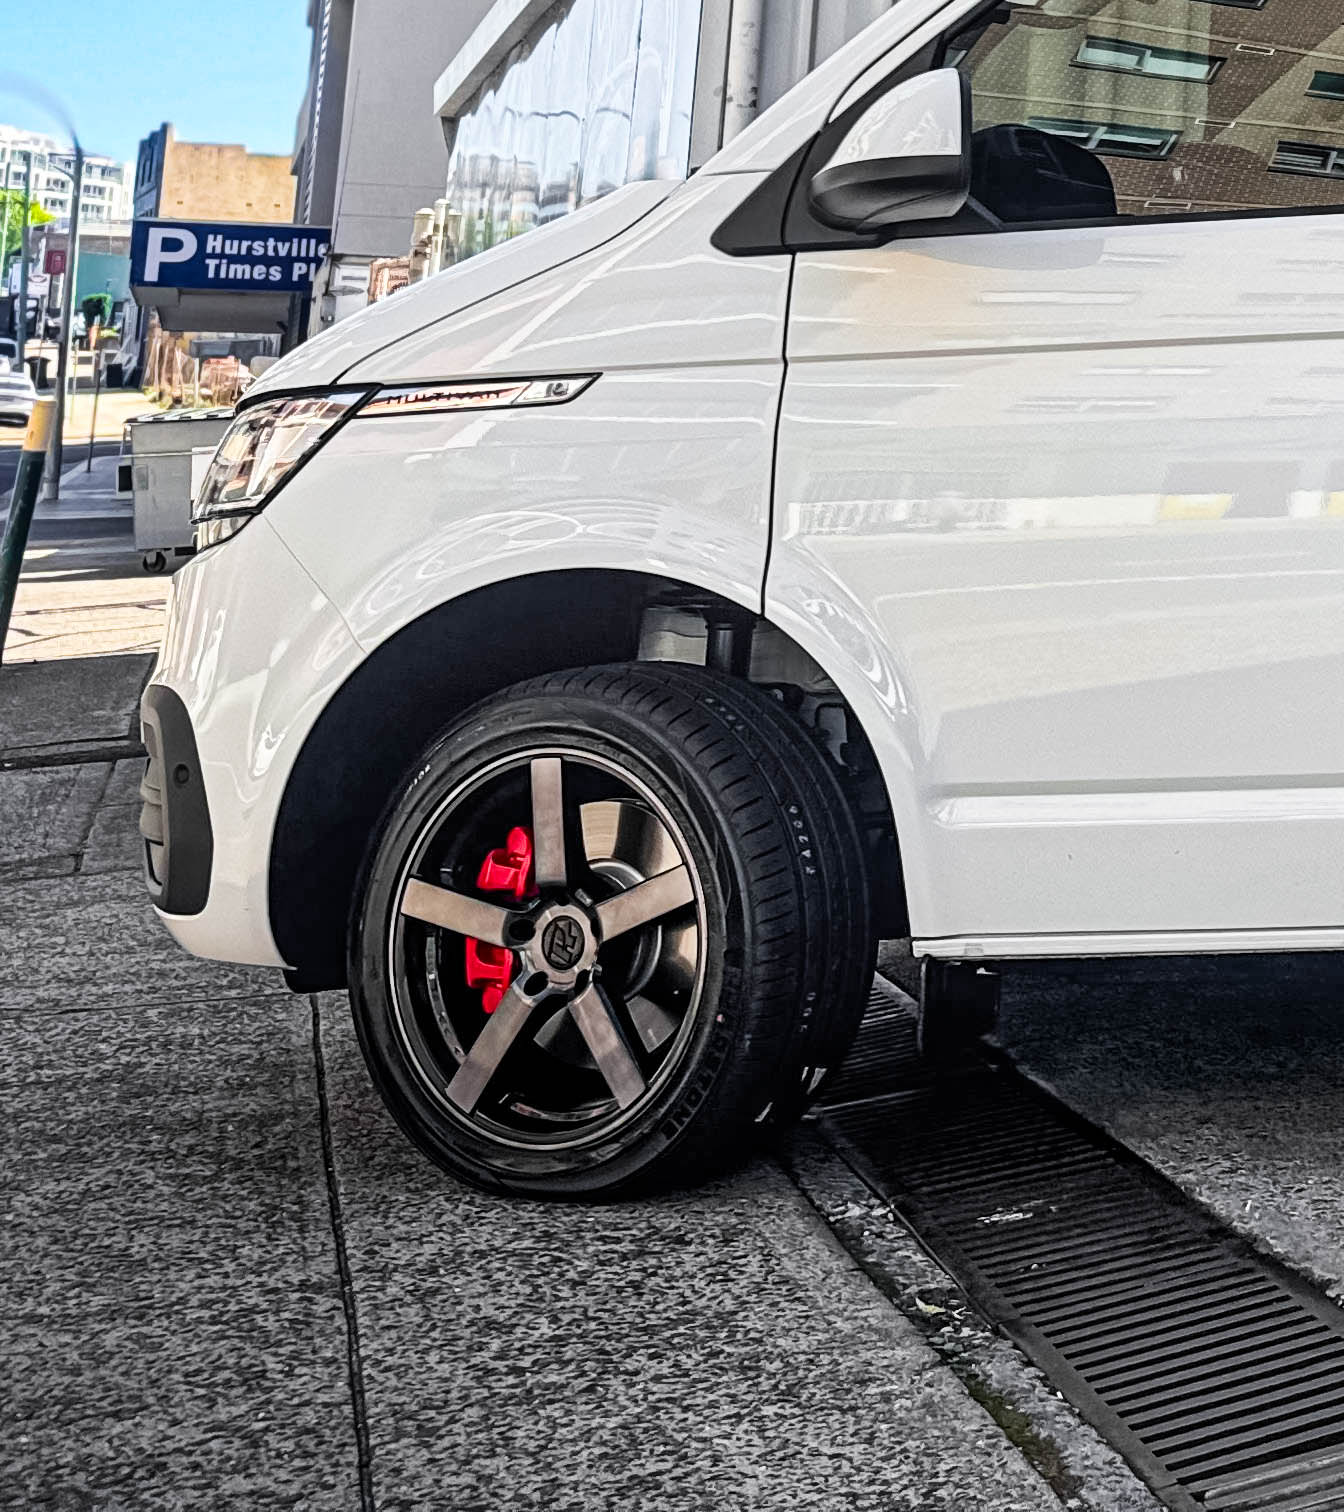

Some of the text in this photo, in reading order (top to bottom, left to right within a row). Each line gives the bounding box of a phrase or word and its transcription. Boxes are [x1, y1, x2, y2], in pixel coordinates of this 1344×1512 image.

[143, 226, 198, 282] P
[204, 258, 317, 282] Times Pl
